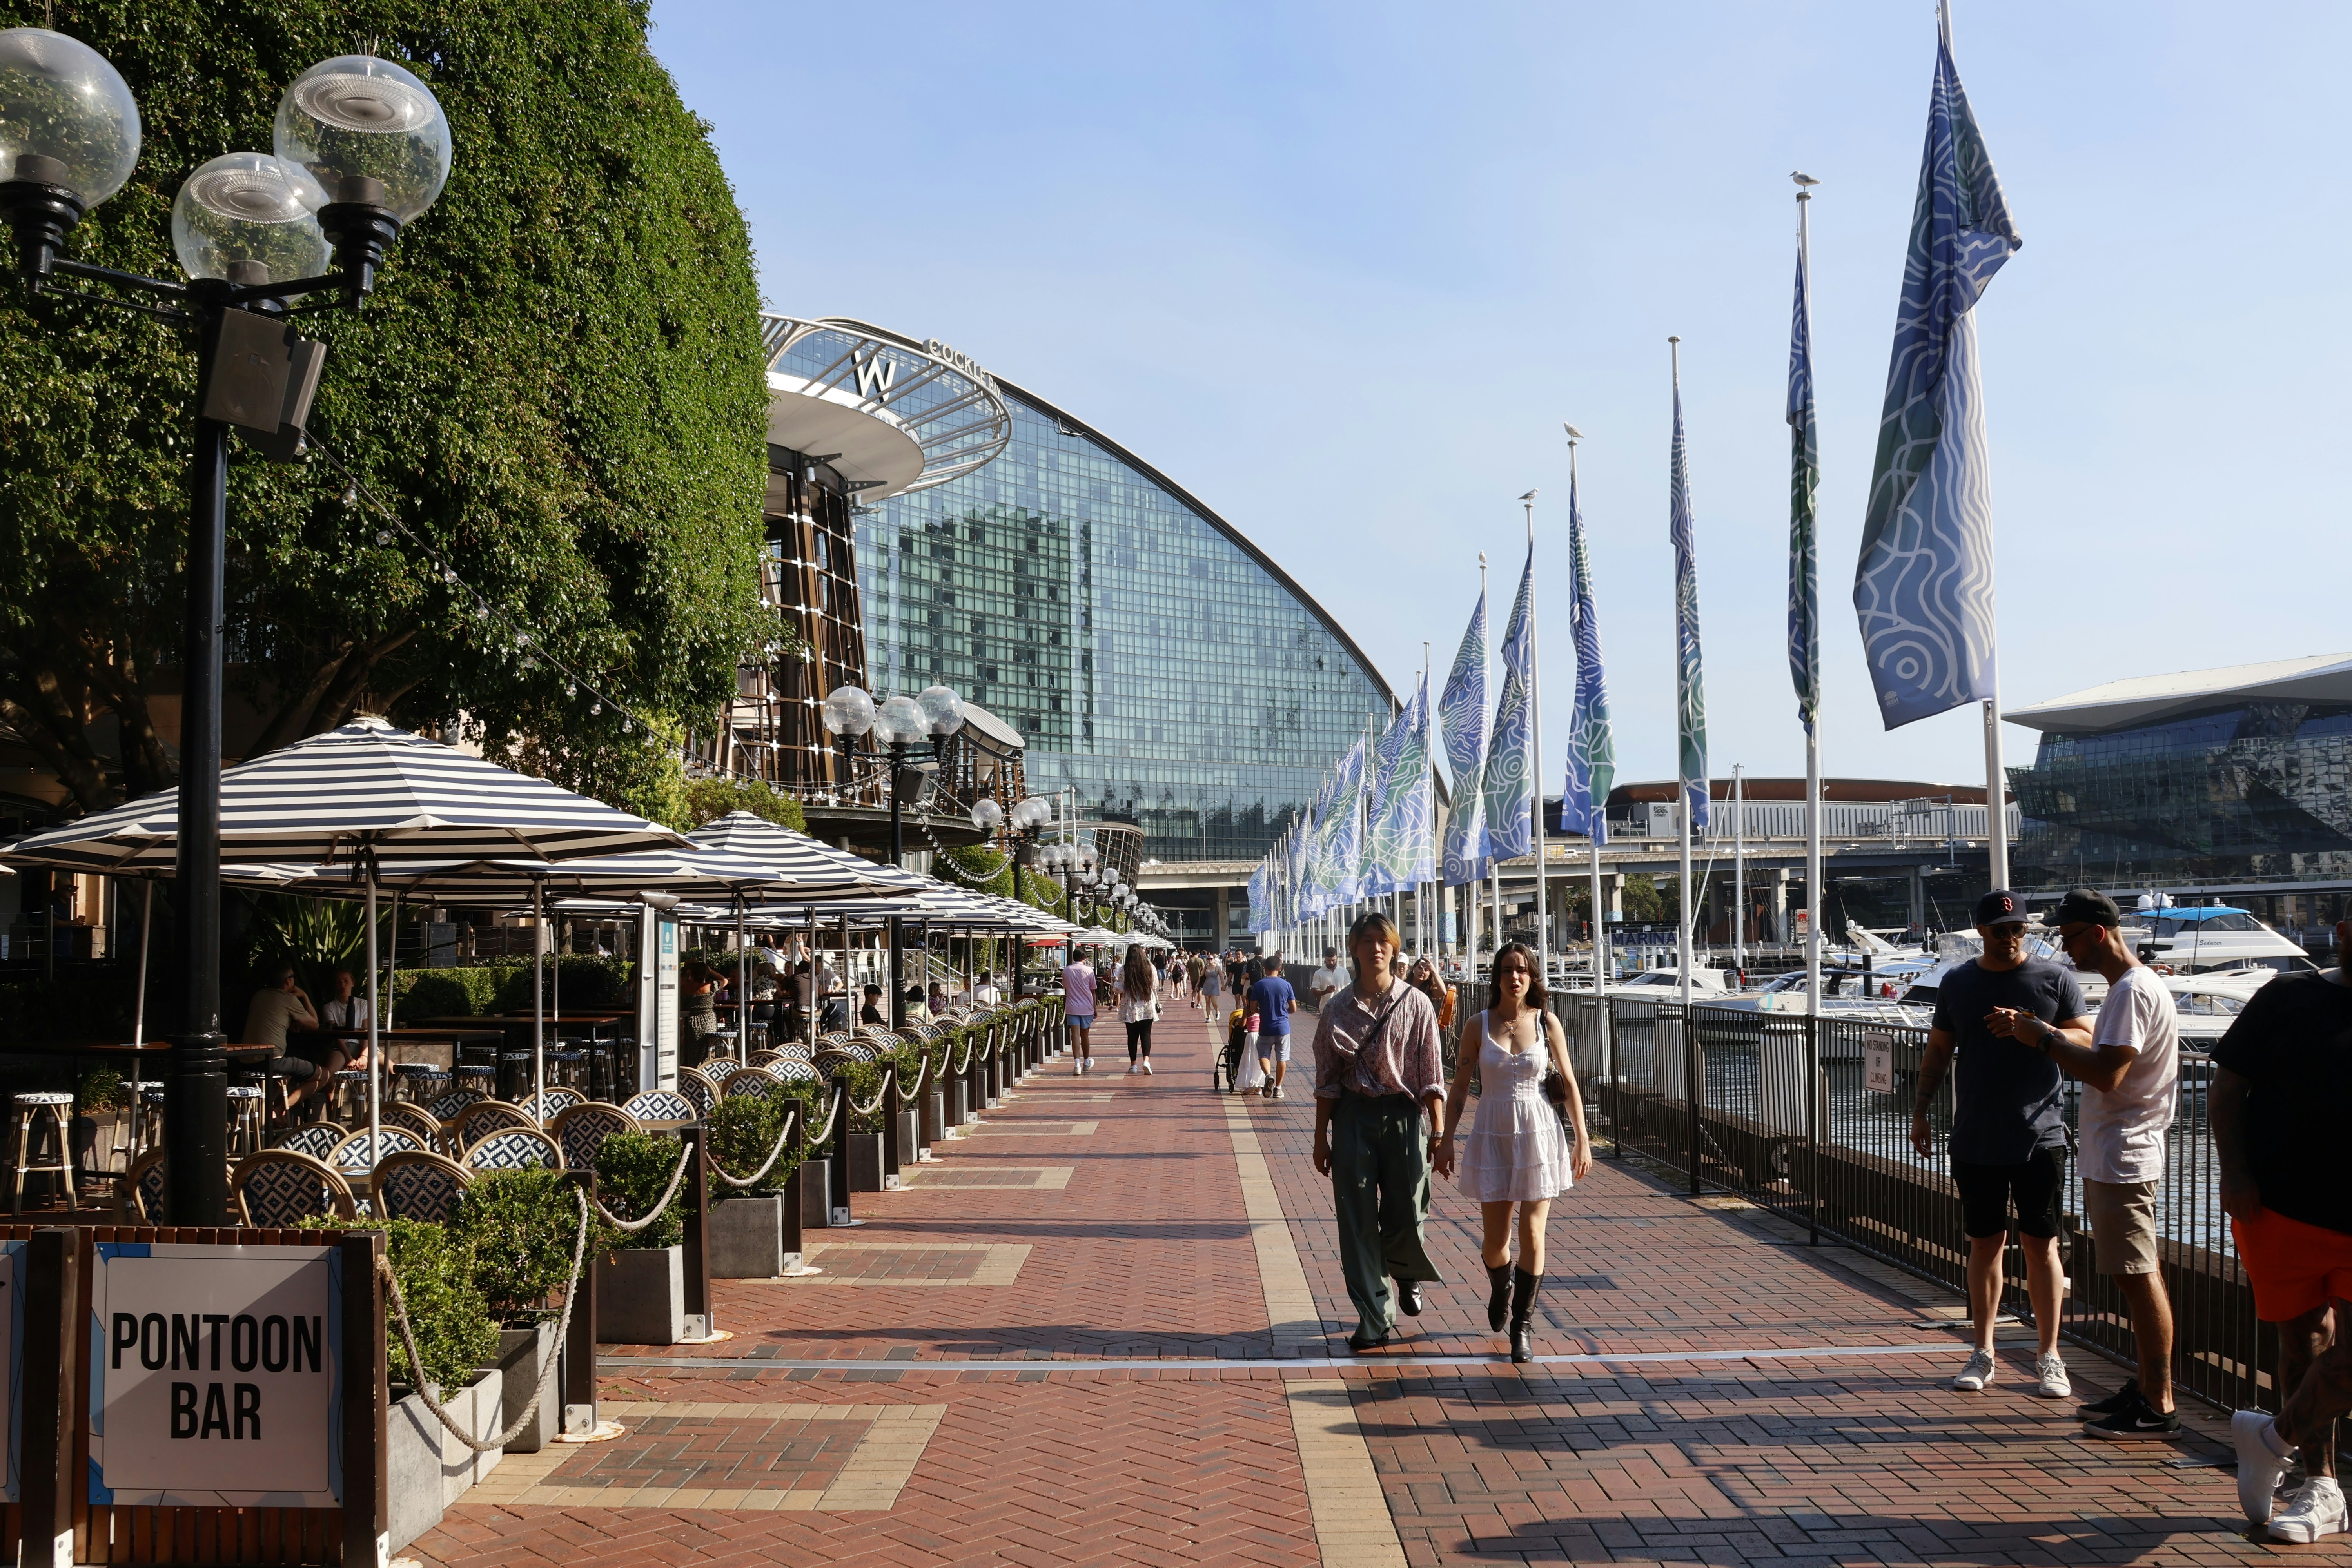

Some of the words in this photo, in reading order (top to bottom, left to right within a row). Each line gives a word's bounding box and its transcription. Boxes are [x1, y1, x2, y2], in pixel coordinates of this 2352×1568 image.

[923, 338, 986, 386] COCKLE
[851, 350, 896, 401] W
[2000, 897, 2013, 911] B
[1612, 932, 1677, 945] MARINA
[1867, 1040, 1872, 1050] NO
[1873, 1040, 1889, 1053] STANDING
[1876, 1056, 1880, 1067] OR
[1871, 1072, 1886, 1084] CLIMBING
[112, 1312, 321, 1372] PONTOON
[171, 1382, 261, 1440] BAR
